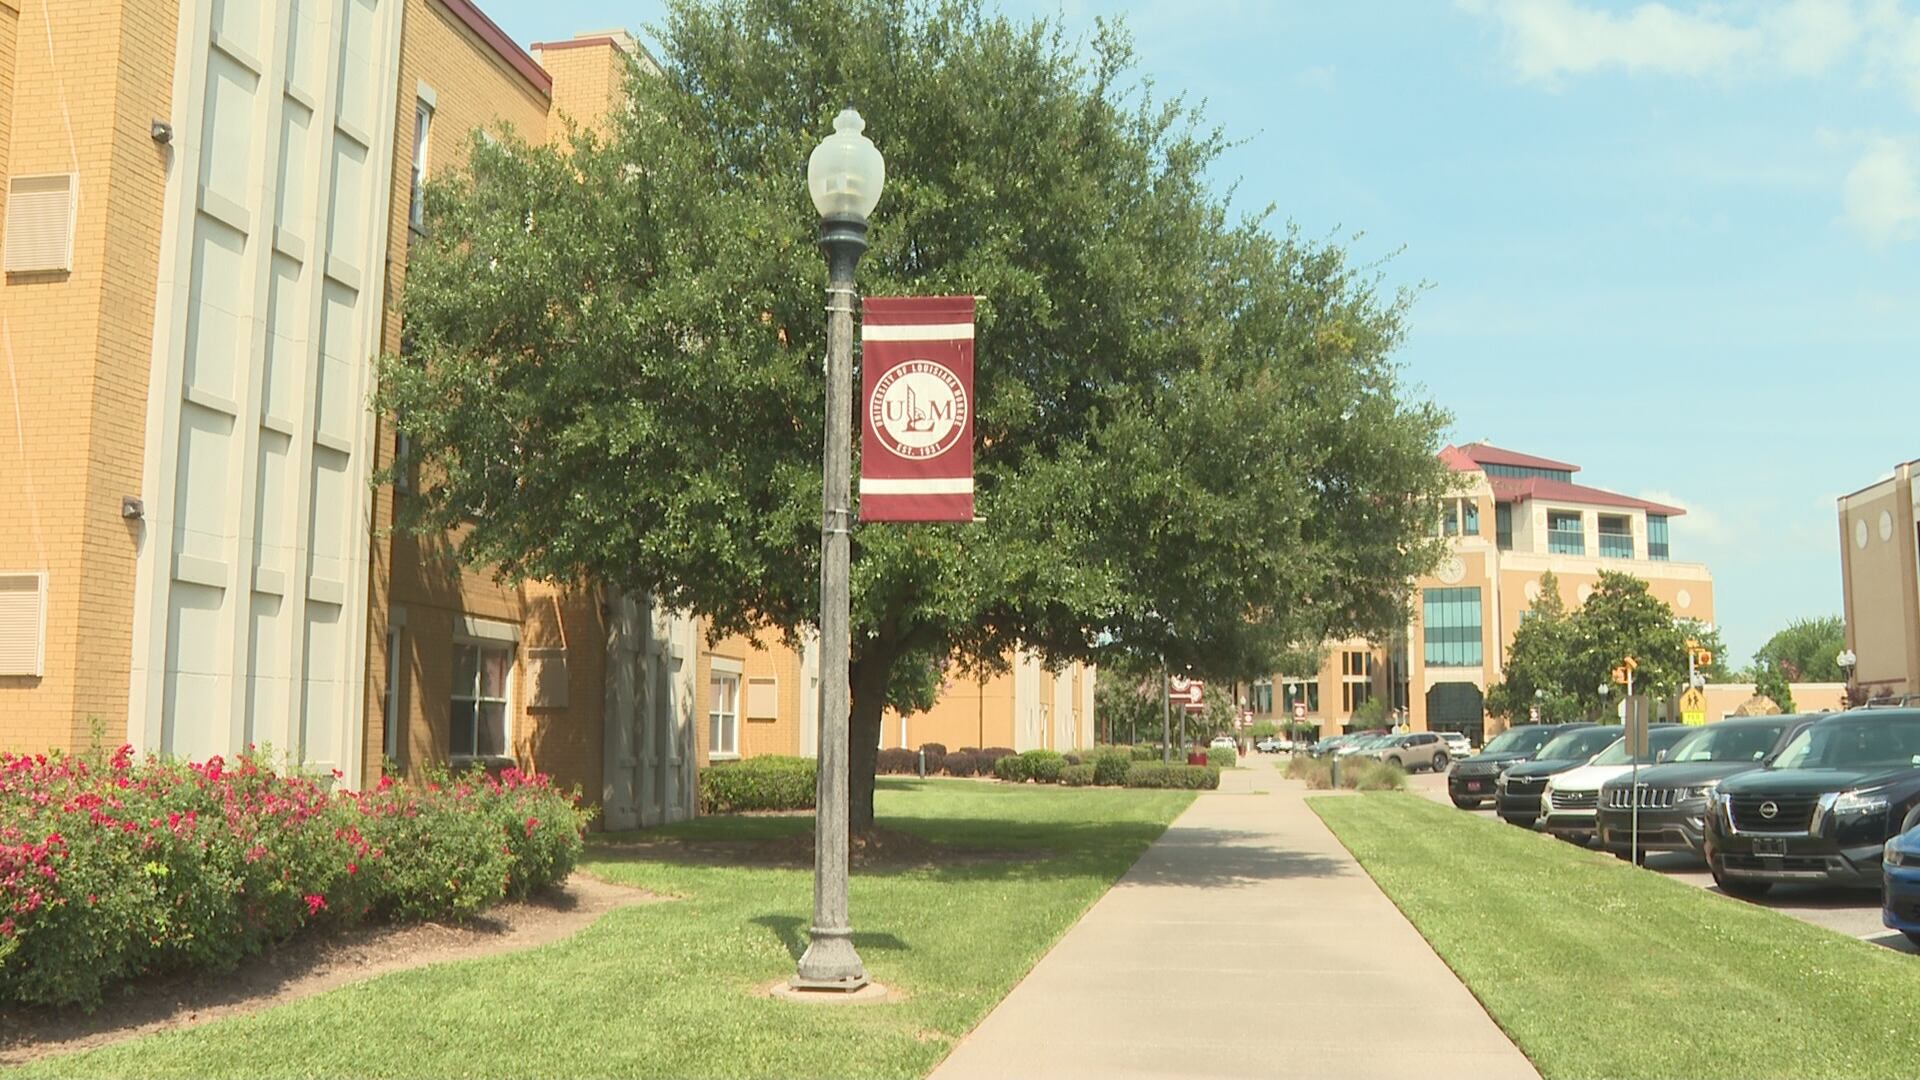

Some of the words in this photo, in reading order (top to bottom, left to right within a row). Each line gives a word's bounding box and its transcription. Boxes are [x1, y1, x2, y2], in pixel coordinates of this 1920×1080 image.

[873, 375, 895, 427] UNIVERSITY
[896, 366, 908, 378] OF
[912, 364, 958, 390] LOUISIANA
[954, 388, 965, 427] MONROE
